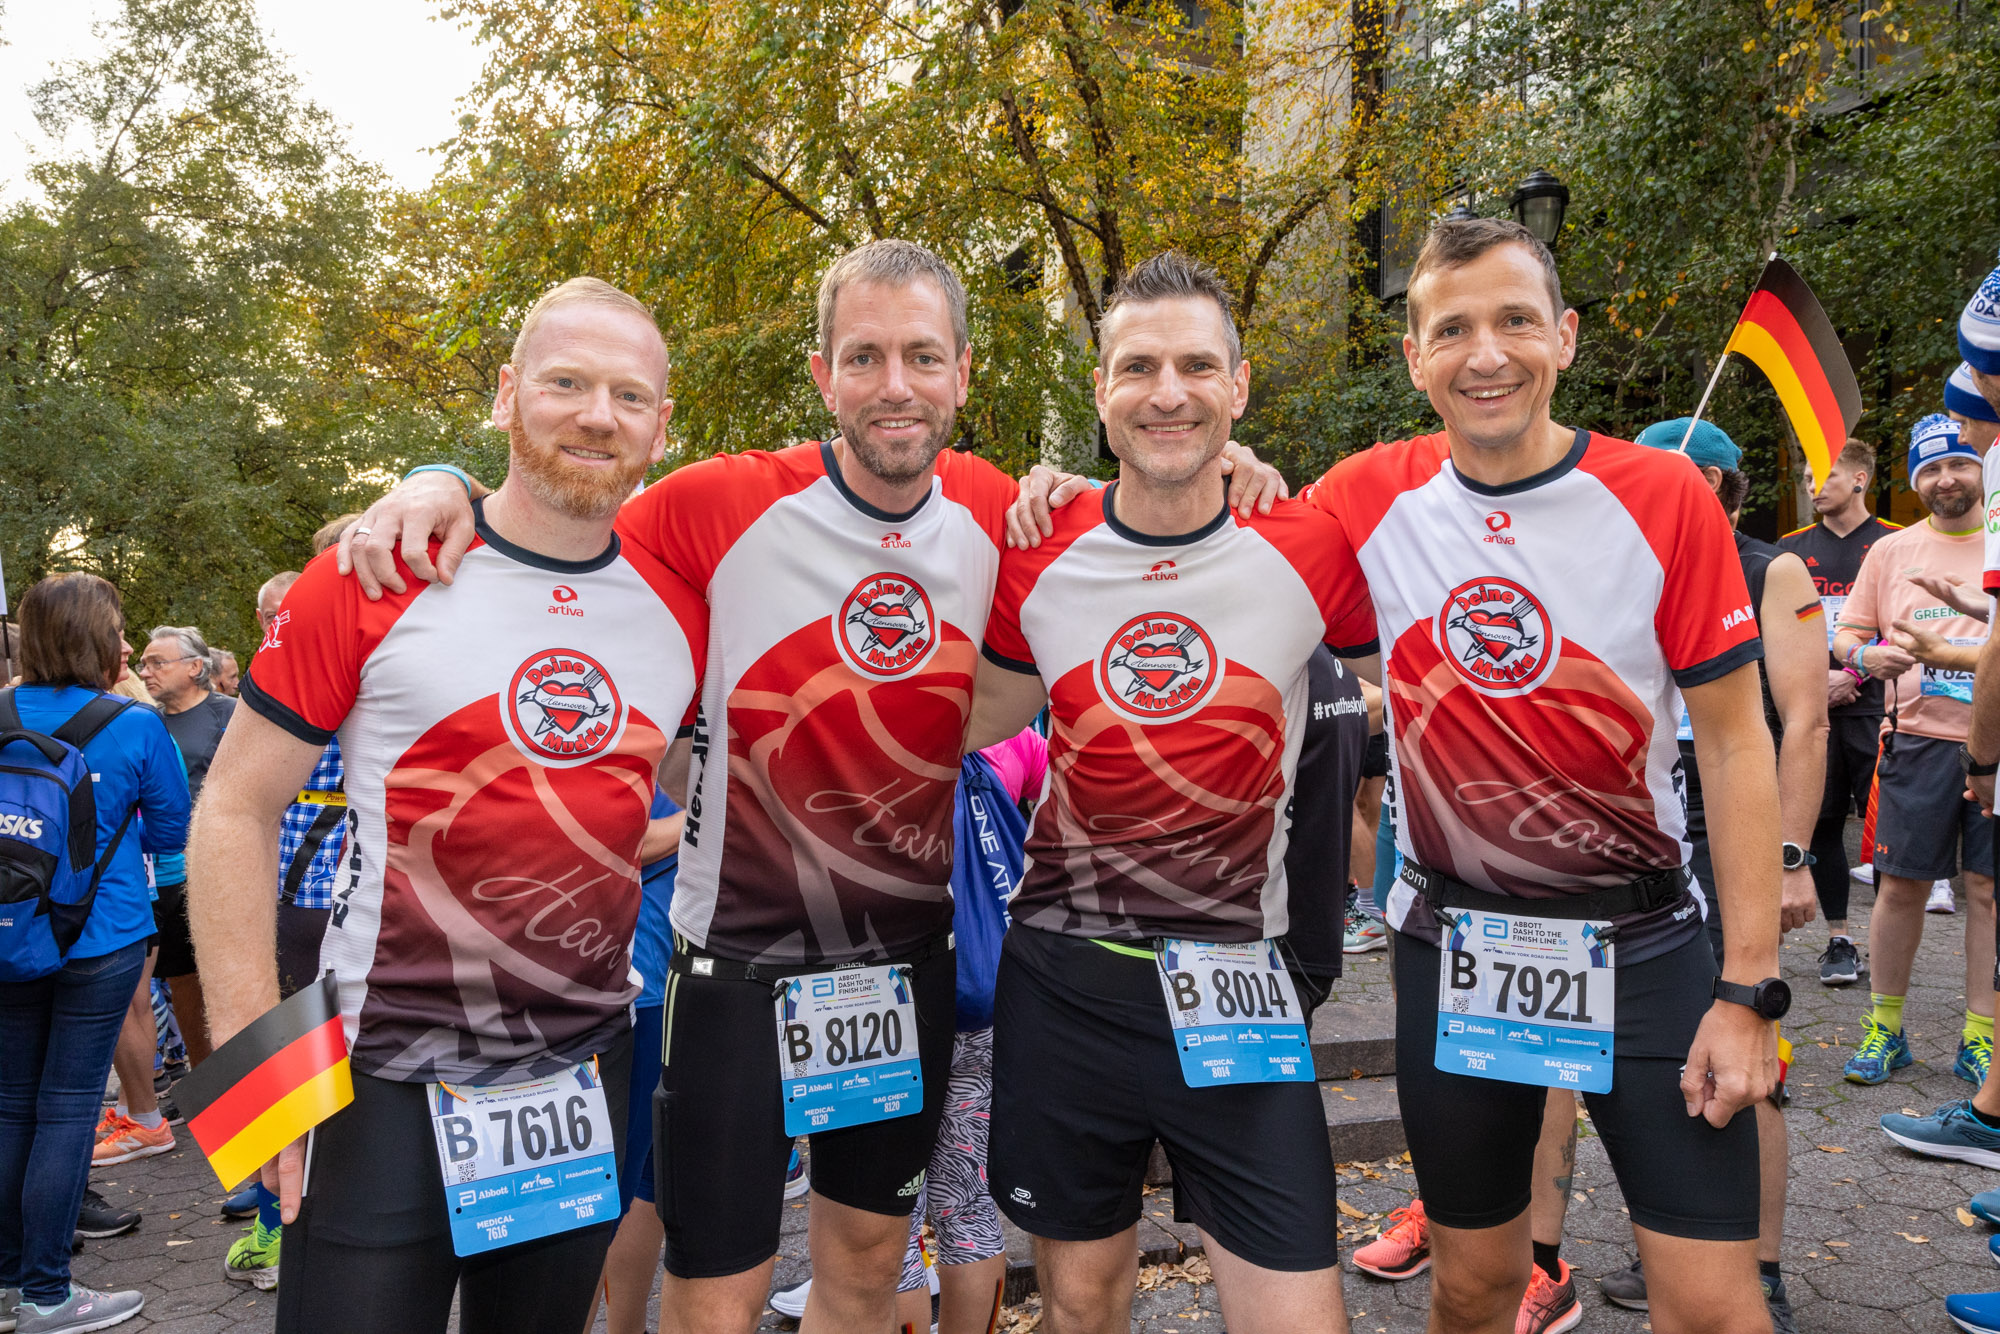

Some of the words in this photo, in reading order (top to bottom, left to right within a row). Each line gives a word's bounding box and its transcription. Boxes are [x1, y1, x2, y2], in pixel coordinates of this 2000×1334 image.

[881, 539, 911, 549] artiva
[1142, 572, 1178, 581] artiva
[856, 580, 905, 608] Deine
[1456, 585, 1515, 613] Deine
[548, 604, 584, 617] artiva
[867, 616, 909, 629] Hannover
[1118, 621, 1179, 651] Deine
[867, 637, 927, 668] Mudda
[1131, 657, 1179, 669] Hannover
[525, 656, 586, 686] Deine
[1132, 676, 1203, 709] Mudda
[541, 695, 589, 711] Hannover
[541, 721, 608, 752] Mudda
[1513, 921, 1542, 929] ABBOTT
[1513, 928, 1533, 936] DASH
[1513, 935, 1538, 943] FINISH
[838, 974, 861, 982] ABBOTT
[1174, 972, 1201, 1011] B
[1212, 968, 1288, 1018] 8014
[1451, 950, 1477, 990] B
[1493, 962, 1592, 1023] 7921
[1466, 1024, 1496, 1036] Abbott
[786, 1023, 813, 1063] B
[825, 1009, 902, 1066] 8120
[1203, 1034, 1228, 1042] Abbott
[1459, 1049, 1496, 1060] MEDICAL
[1203, 1058, 1235, 1068] MEDICAL
[1280, 1064, 1296, 1075] 8014
[1467, 1058, 1487, 1071] 7921
[1544, 1060, 1561, 1068] BAG
[1563, 1062, 1592, 1072] CHECK
[1212, 1067, 1230, 1078] 8014
[1559, 1069, 1579, 1083] 7921
[808, 1083, 833, 1093] Abbott
[873, 1096, 887, 1104] BAG
[888, 1092, 909, 1101] CHECK
[805, 1106, 835, 1116] MEDICAL
[884, 1100, 900, 1113] 8120
[811, 1114, 828, 1126] 8120
[443, 1115, 478, 1163] B
[489, 1095, 592, 1167] 7616
[478, 1186, 508, 1200] Abbott
[560, 1199, 576, 1209] BAG
[577, 1193, 603, 1204] CHECK
[575, 1204, 595, 1219] 7616
[476, 1214, 515, 1229] MEDICAL
[486, 1225, 508, 1241] 7616
